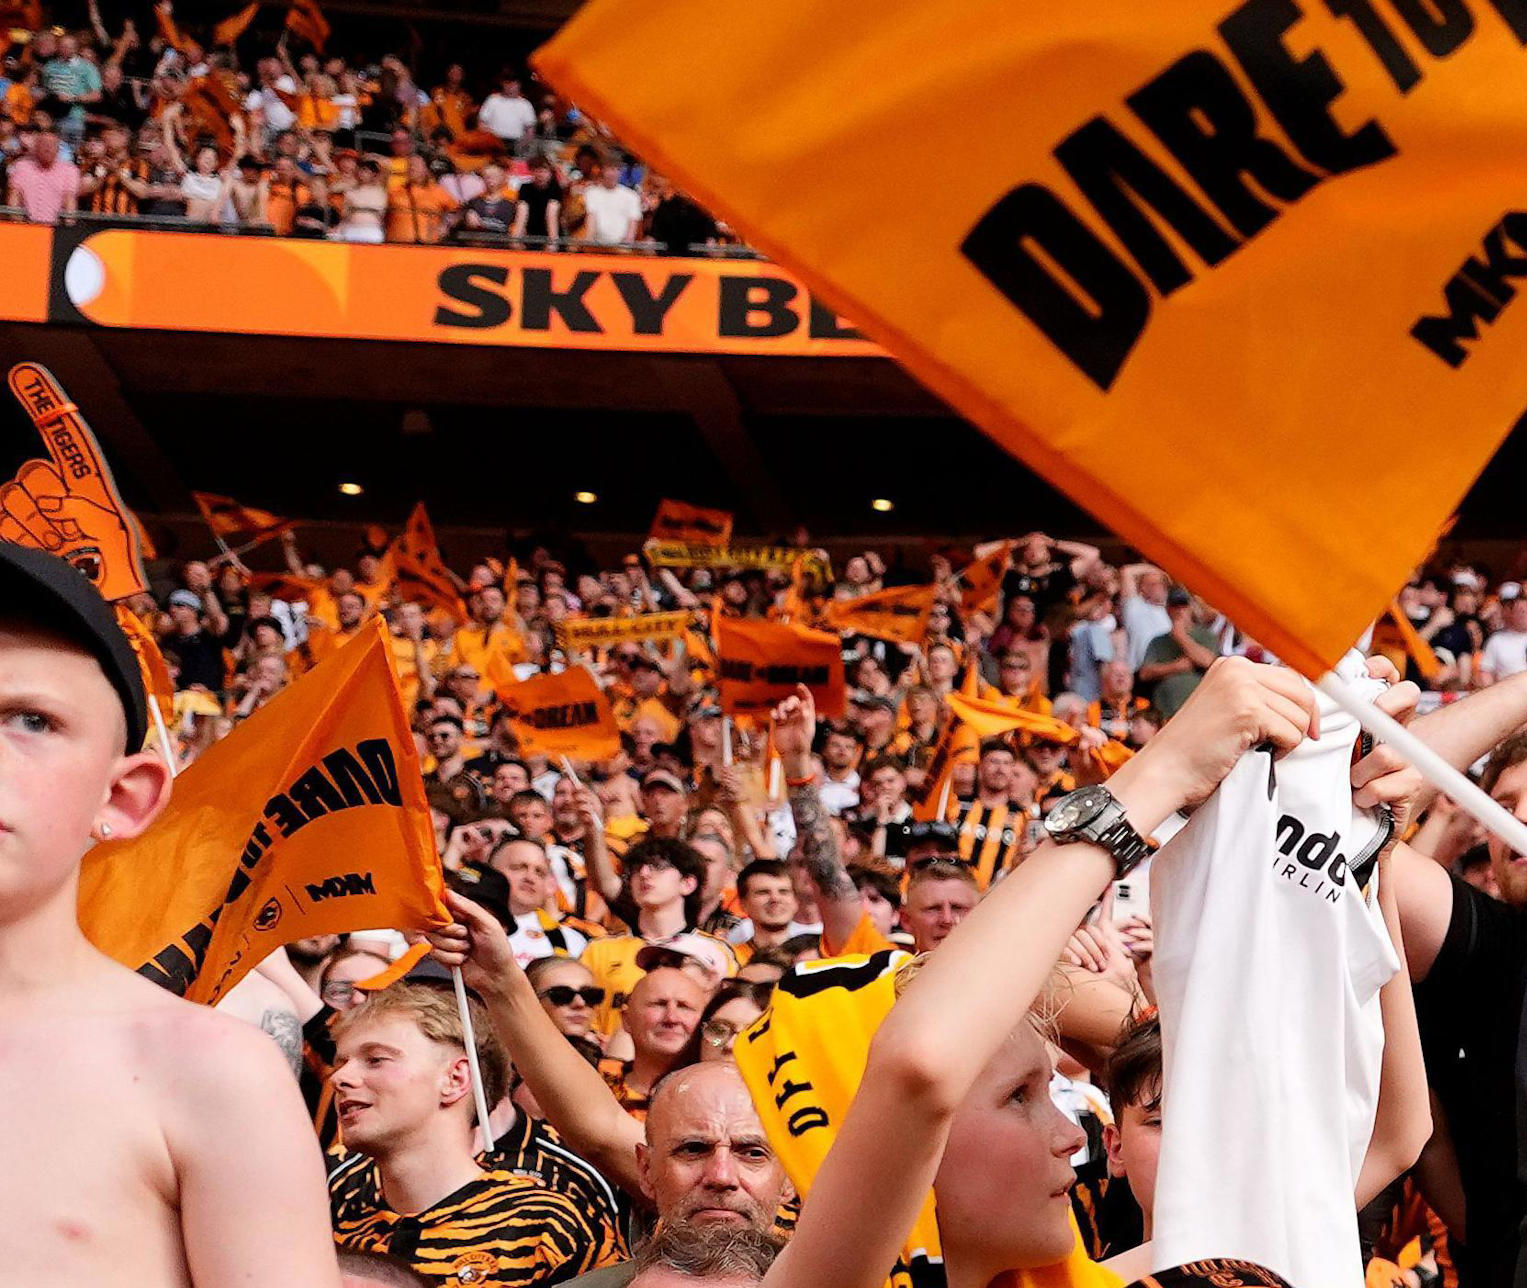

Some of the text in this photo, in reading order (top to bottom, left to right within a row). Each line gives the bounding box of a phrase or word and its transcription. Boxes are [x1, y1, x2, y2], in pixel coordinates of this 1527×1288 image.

[958, 0, 1400, 394] DARE
[434, 263, 603, 336] SKY
[24, 377, 91, 480] THE TIGERS
